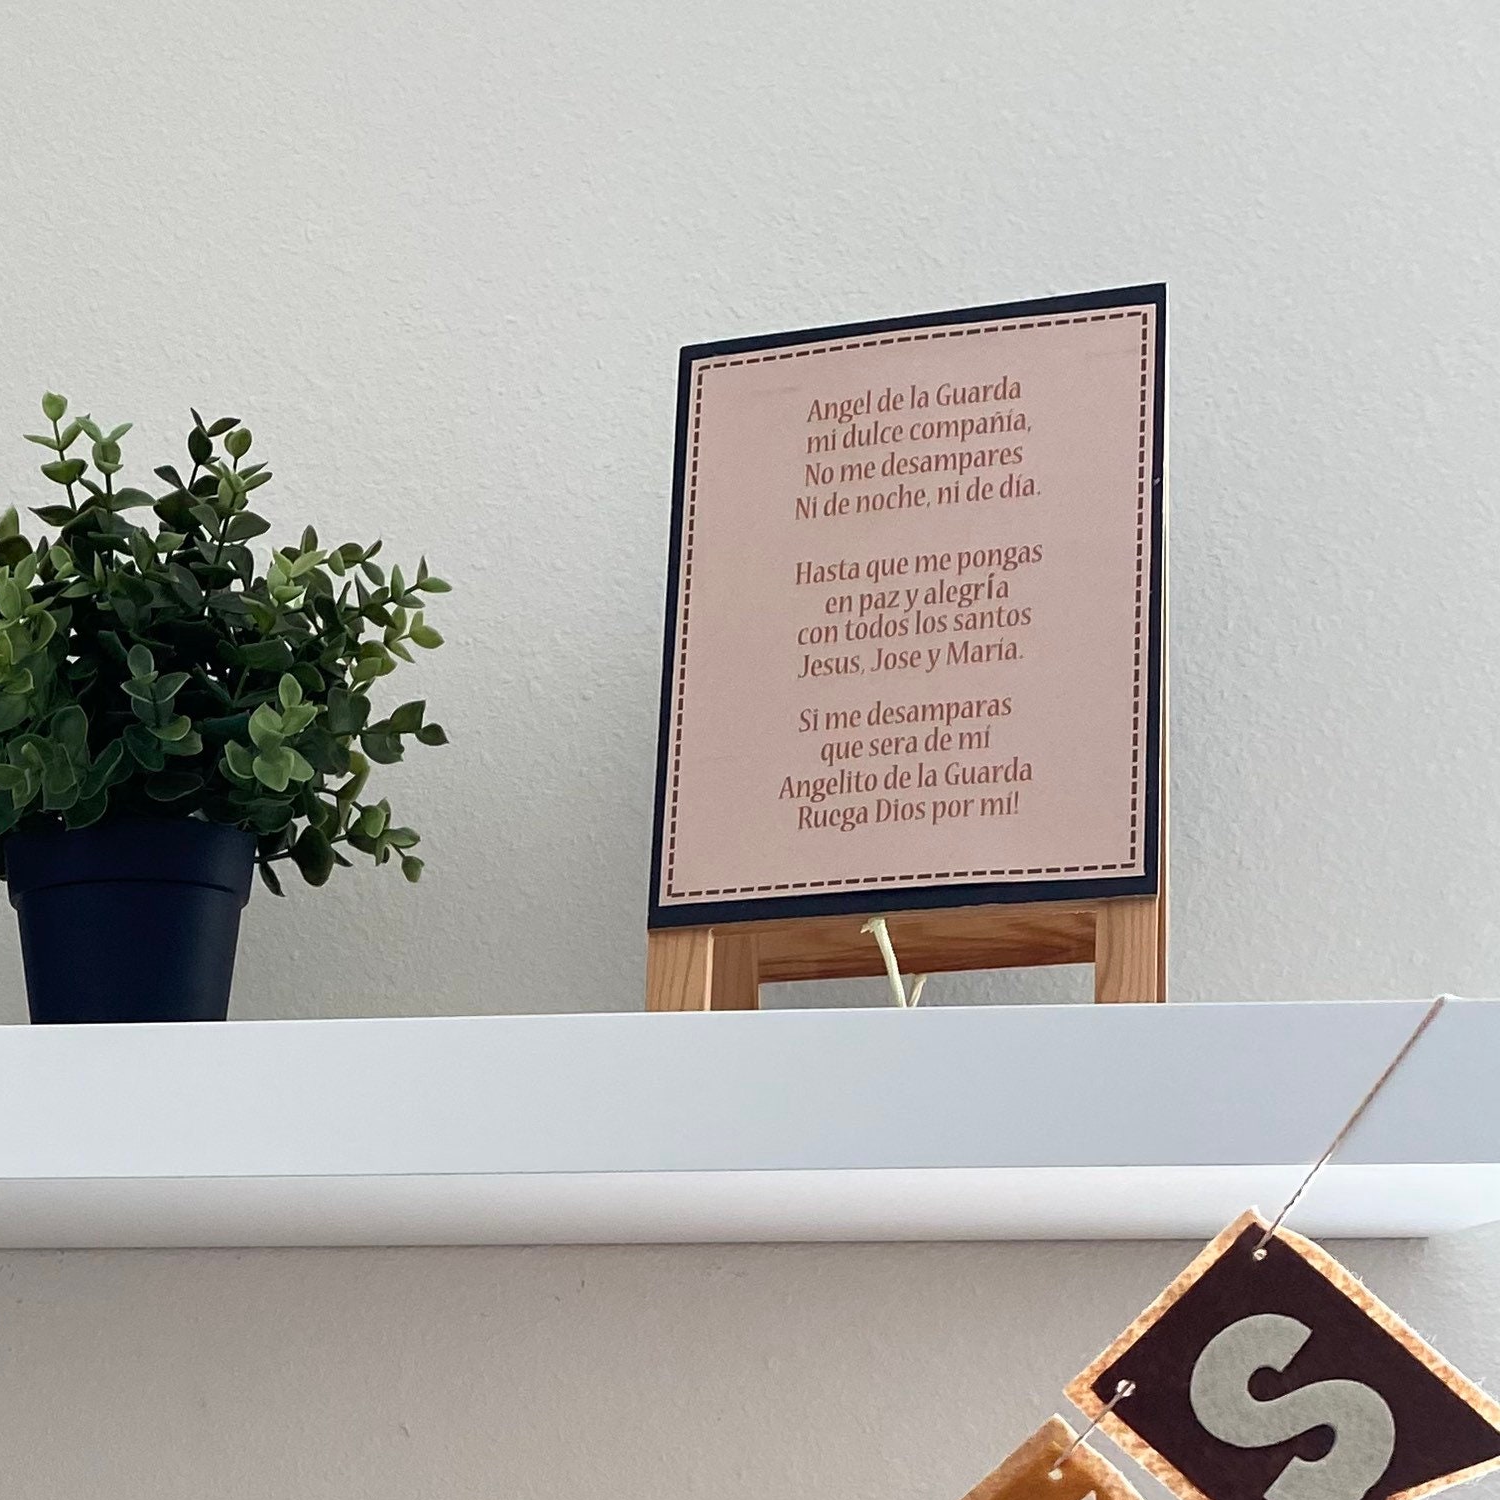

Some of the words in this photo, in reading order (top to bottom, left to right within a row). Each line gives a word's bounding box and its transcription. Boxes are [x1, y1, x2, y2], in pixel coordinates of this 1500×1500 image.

[807, 391, 872, 424] Angel
[877, 388, 904, 413] de
[910, 385, 929, 410] la
[936, 376, 1021, 406] Guarda
[806, 429, 836, 453] mi
[843, 421, 903, 449] dulce
[910, 409, 1032, 442] compañía,
[805, 463, 833, 486] No
[840, 460, 875, 482] me
[881, 446, 1023, 477] desampares
[795, 497, 817, 520] Ni
[823, 491, 850, 517] de
[856, 484, 931, 512] noche,
[938, 481, 959, 504] ni
[966, 477, 993, 502] de
[999, 473, 1041, 498] día.
[796, 559, 859, 585] Hasta
[866, 558, 908, 583] que
[915, 553, 951, 573] me
[957, 544, 1043, 575] pongas
[825, 595, 852, 614] en
[859, 590, 899, 617] paz
[905, 588, 919, 613] y
[924, 573, 1009, 608] alegría
[797, 625, 838, 645] con
[845, 613, 908, 642] todos
[915, 610, 947, 634] los
[953, 606, 1032, 631] santos
[798, 654, 865, 678] Jesus,
[871, 648, 921, 672] Jose
[926, 648, 941, 672] y
[947, 637, 1024, 666] María.
[799, 708, 818, 733] Si
[825, 709, 861, 731] me
[867, 697, 1012, 726] desamparas
[821, 740, 863, 766] que
[868, 734, 918, 757] sera
[924, 726, 952, 752] de
[958, 725, 991, 750] mí
[779, 768, 877, 803] Angelito
[884, 765, 911, 790] de
[917, 762, 937, 788] la
[945, 756, 1033, 786] Guarda
[875, 798, 925, 824] Dios
[932, 801, 975, 825] por
[980, 791, 1019, 816] mí!
